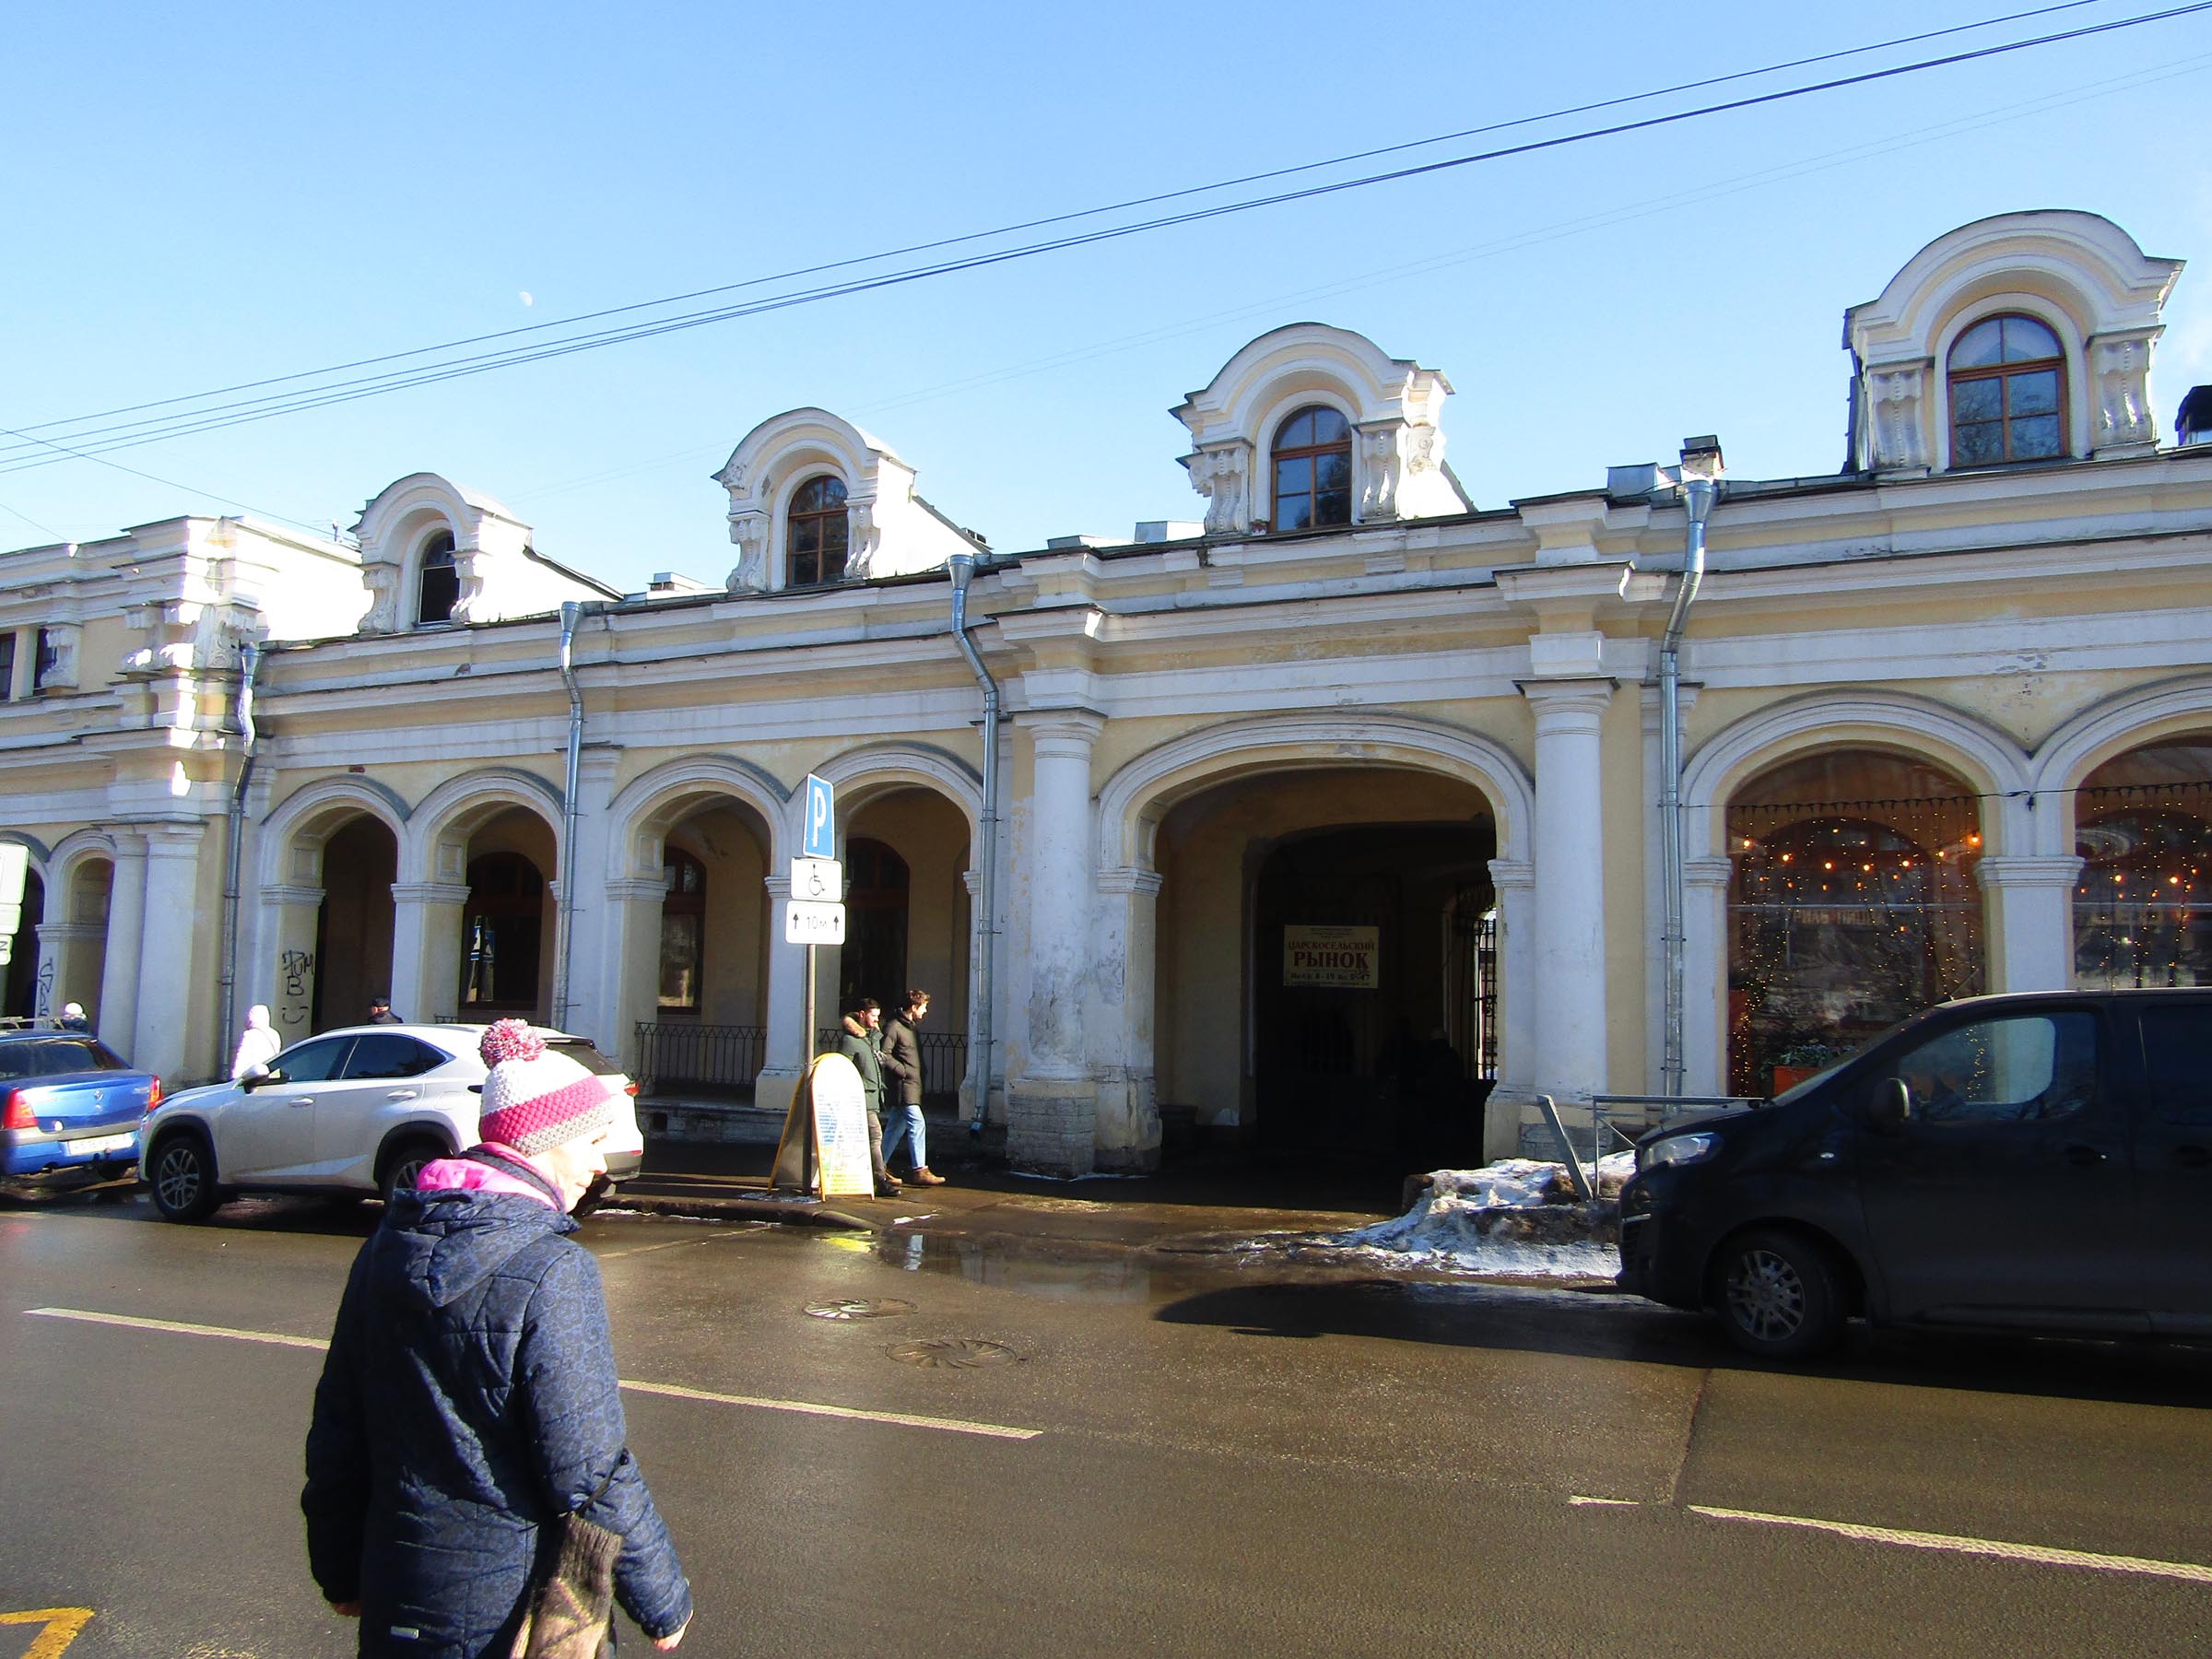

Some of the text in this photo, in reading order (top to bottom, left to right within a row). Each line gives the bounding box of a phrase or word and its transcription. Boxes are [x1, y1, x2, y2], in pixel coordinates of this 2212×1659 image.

[812, 785, 827, 848] P
[1288, 938, 1374, 951] ЦАРСКОСЕЛЬСКИЙ
[1293, 951, 1369, 969] РЫНОК
